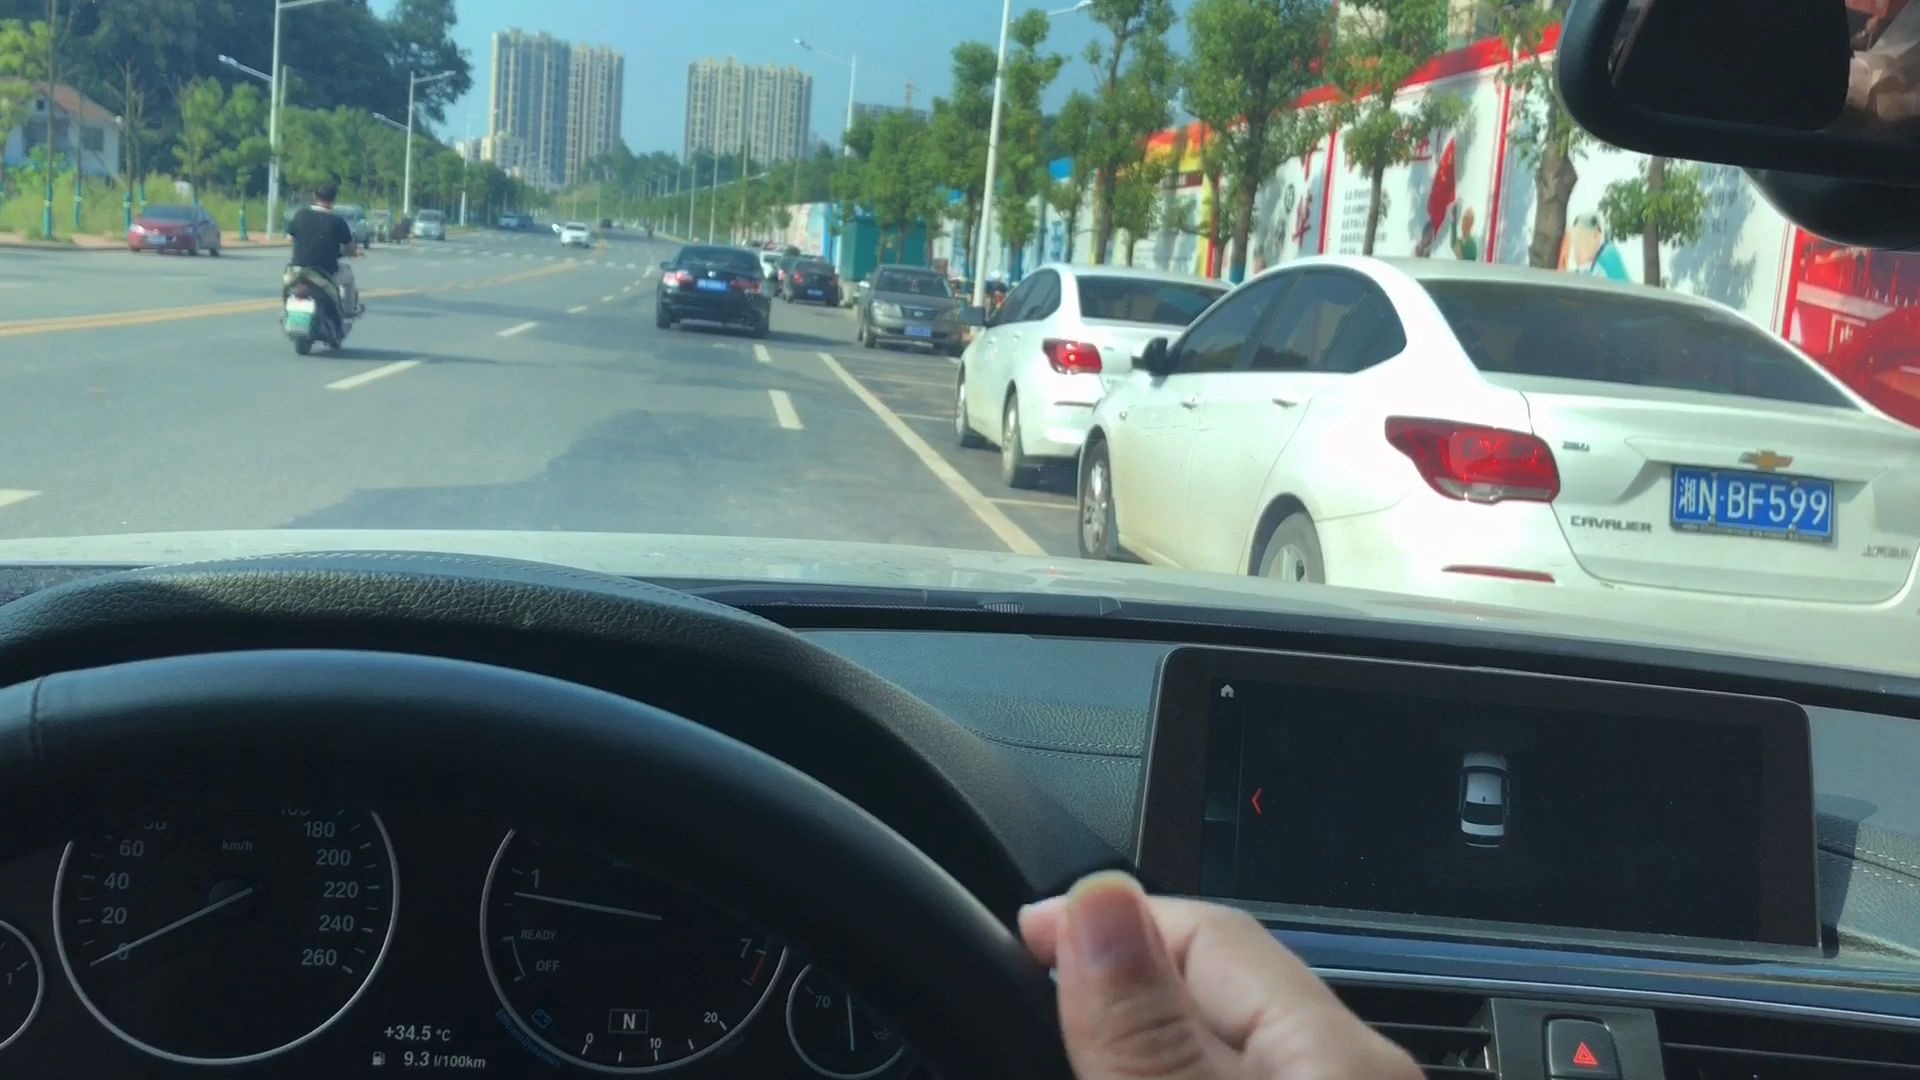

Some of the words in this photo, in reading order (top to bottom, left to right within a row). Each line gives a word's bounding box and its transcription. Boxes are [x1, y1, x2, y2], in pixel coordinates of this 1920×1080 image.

[1678, 475, 1828, 526] 湘N·BF599
[1570, 514, 1653, 533] CAVALIER
[304, 820, 336, 838] 180
[119, 839, 144, 857] 60
[222, 839, 254, 852] km/h
[316, 848, 351, 866] 200
[104, 872, 130, 890] 40
[531, 869, 541, 889] 1
[323, 880, 359, 899] 220
[101, 906, 127, 925] 20
[318, 914, 354, 932] 240
[520, 929, 557, 941] READY
[301, 948, 337, 966] 260
[740, 938, 753, 958] 7
[535, 959, 561, 972] OFF
[814, 994, 832, 1009] 70
[622, 1013, 636, 1030] N
[703, 1011, 719, 1024] 20
[384, 1024, 431, 1041] +34.5
[585, 1032, 594, 1045] 0
[649, 1037, 662, 1050] 10
[403, 1051, 430, 1067] 9.3
